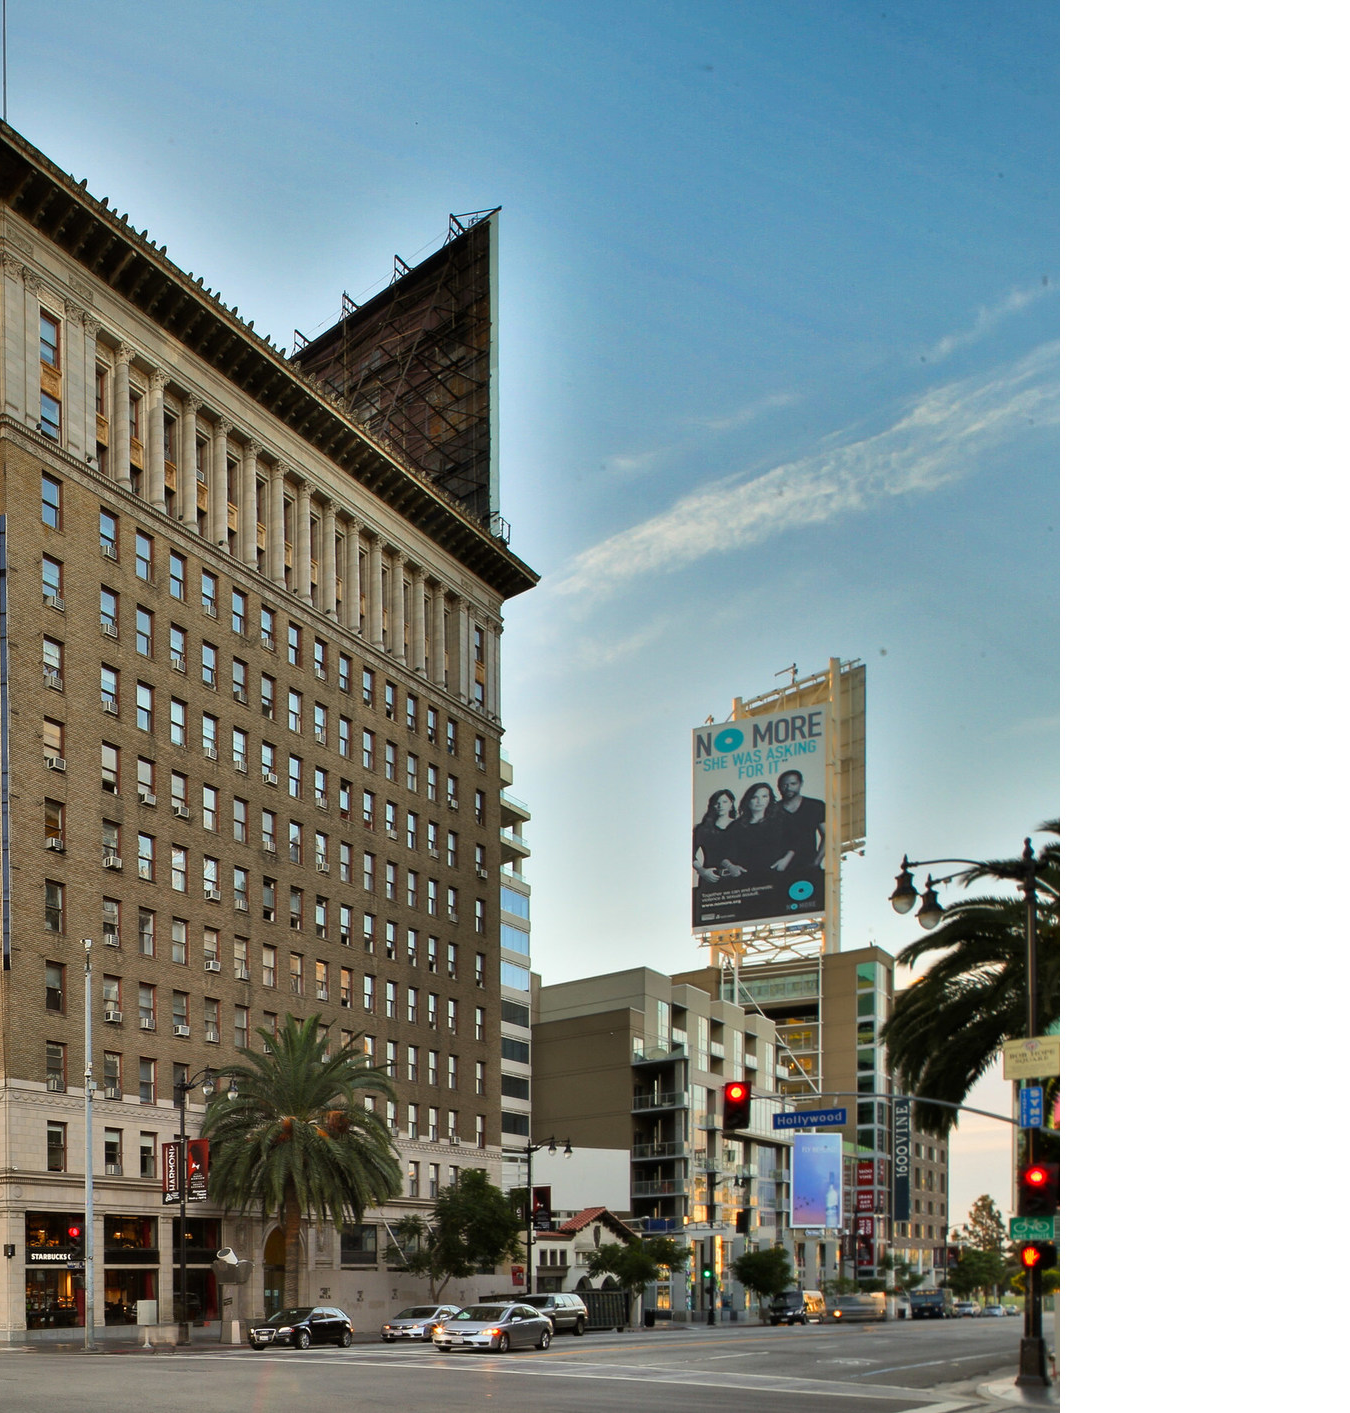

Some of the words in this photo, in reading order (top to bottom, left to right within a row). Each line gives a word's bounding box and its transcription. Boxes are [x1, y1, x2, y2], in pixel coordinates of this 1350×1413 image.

[696, 728, 744, 758] NO
[752, 711, 822, 748] MORE
[732, 749, 762, 767] WAS
[765, 739, 817, 764] ASKING
[738, 763, 764, 780] FOR
[777, 1111, 843, 1126] Hollywood
[168, 1145, 176, 1191] HARMONY
